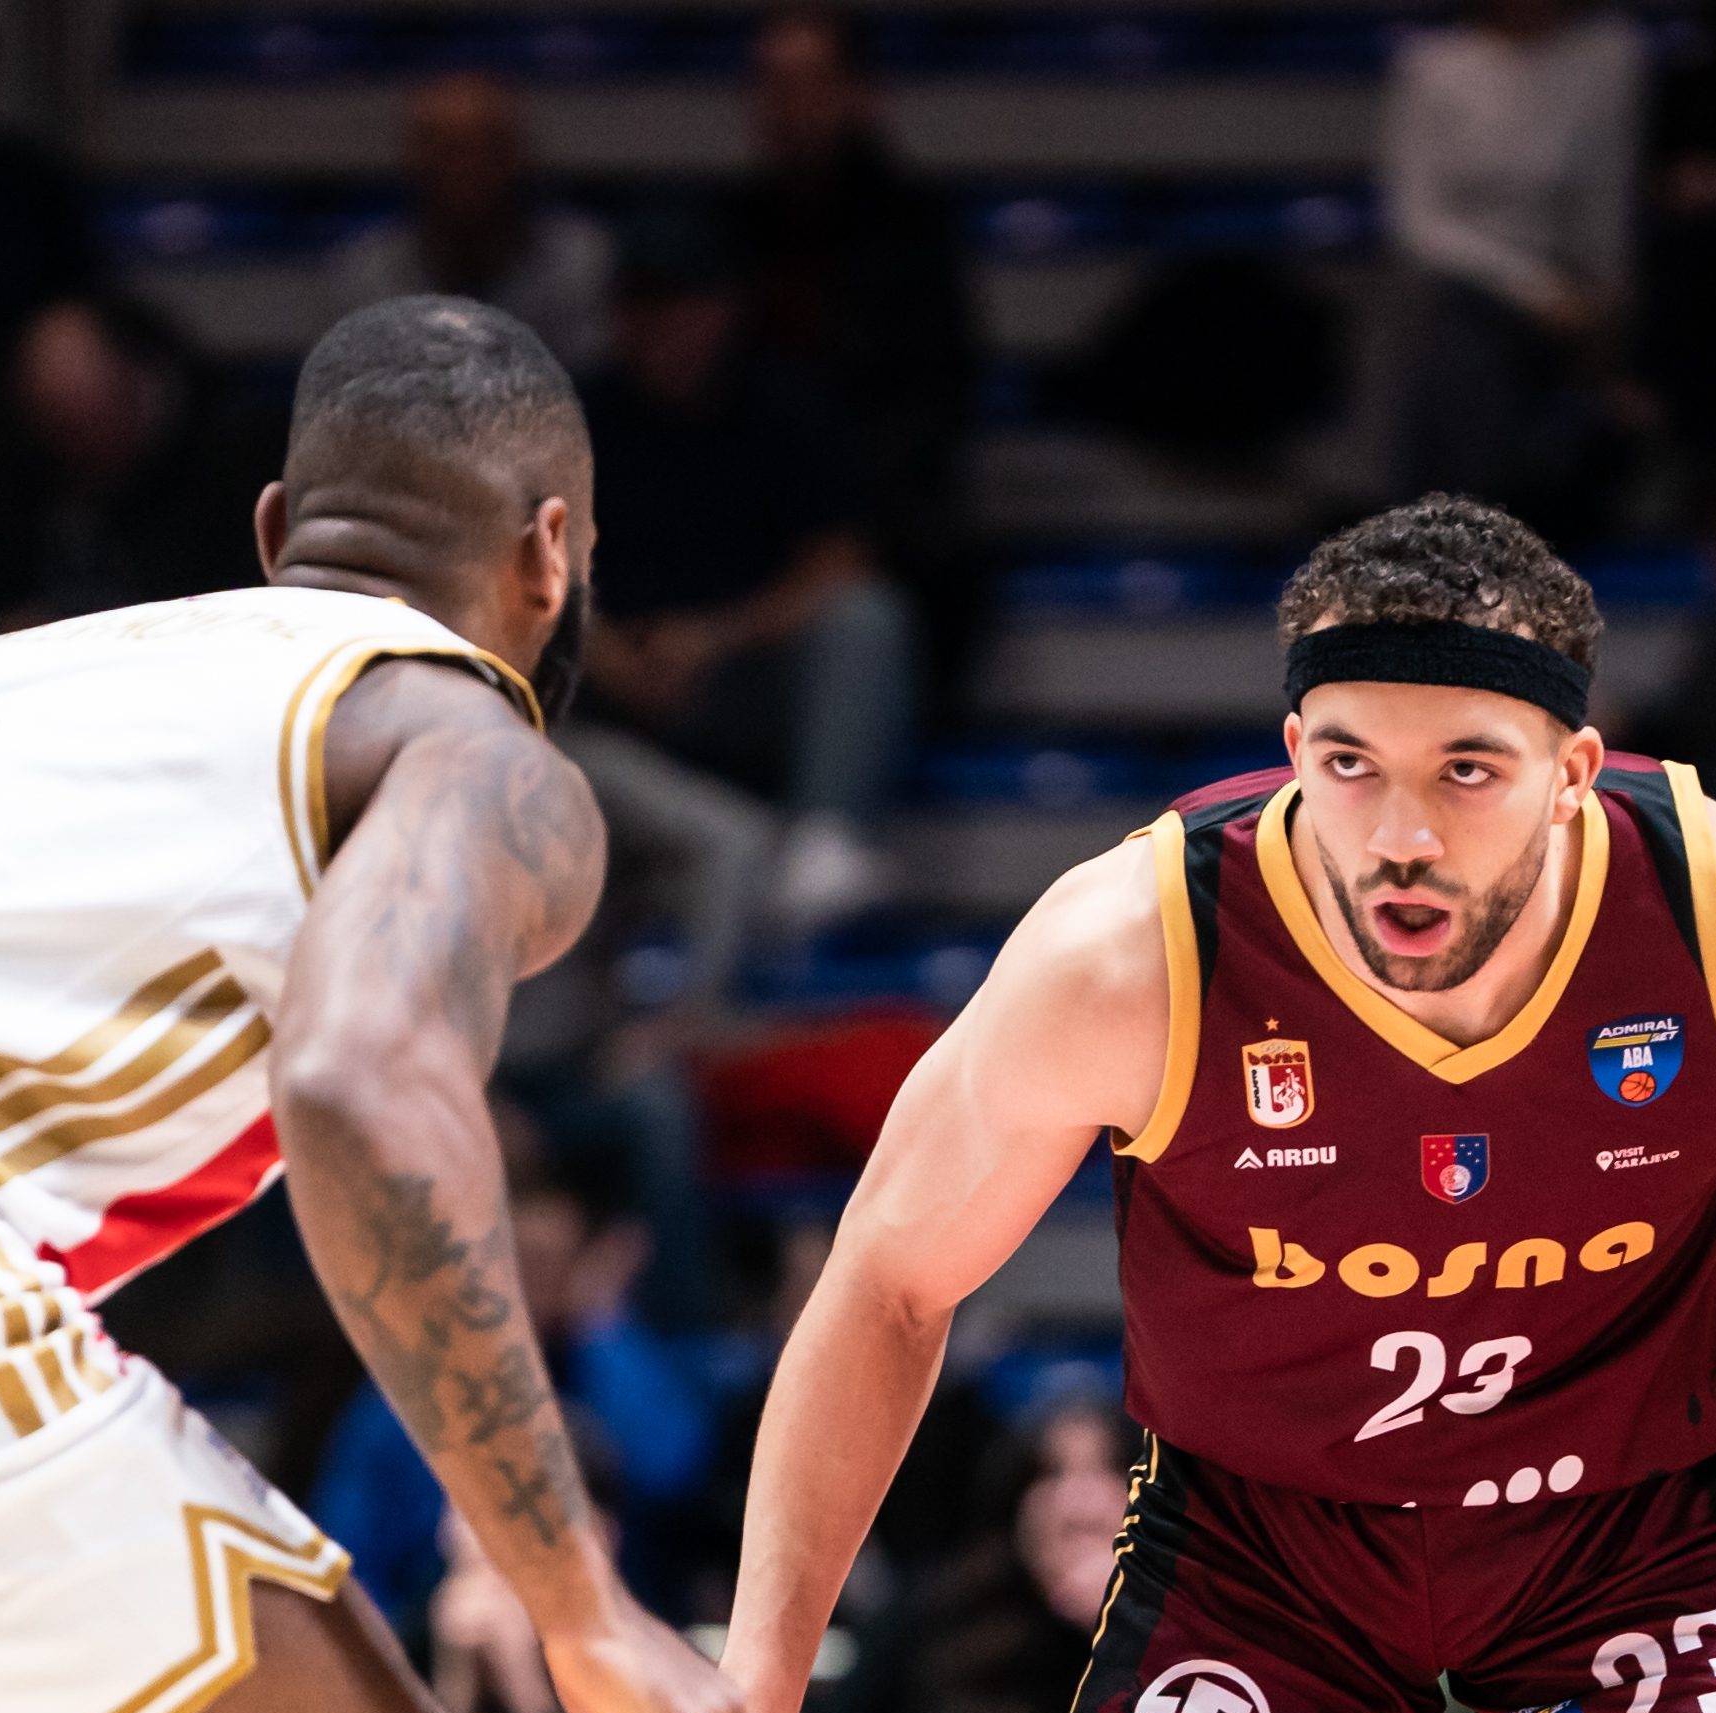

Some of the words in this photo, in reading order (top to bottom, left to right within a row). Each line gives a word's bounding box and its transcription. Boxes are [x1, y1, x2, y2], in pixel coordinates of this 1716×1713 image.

[1598, 1018, 1679, 1038] ADMIRAL
[1622, 1046, 1654, 1069] ABA
[1266, 1146, 1337, 1168] ARDU
[1613, 1146, 1645, 1159] VISIT
[1614, 1151, 1680, 1169] SARAJEVO
[1248, 1221, 1655, 1298] bosna
[1354, 1330, 1533, 1443] 23
